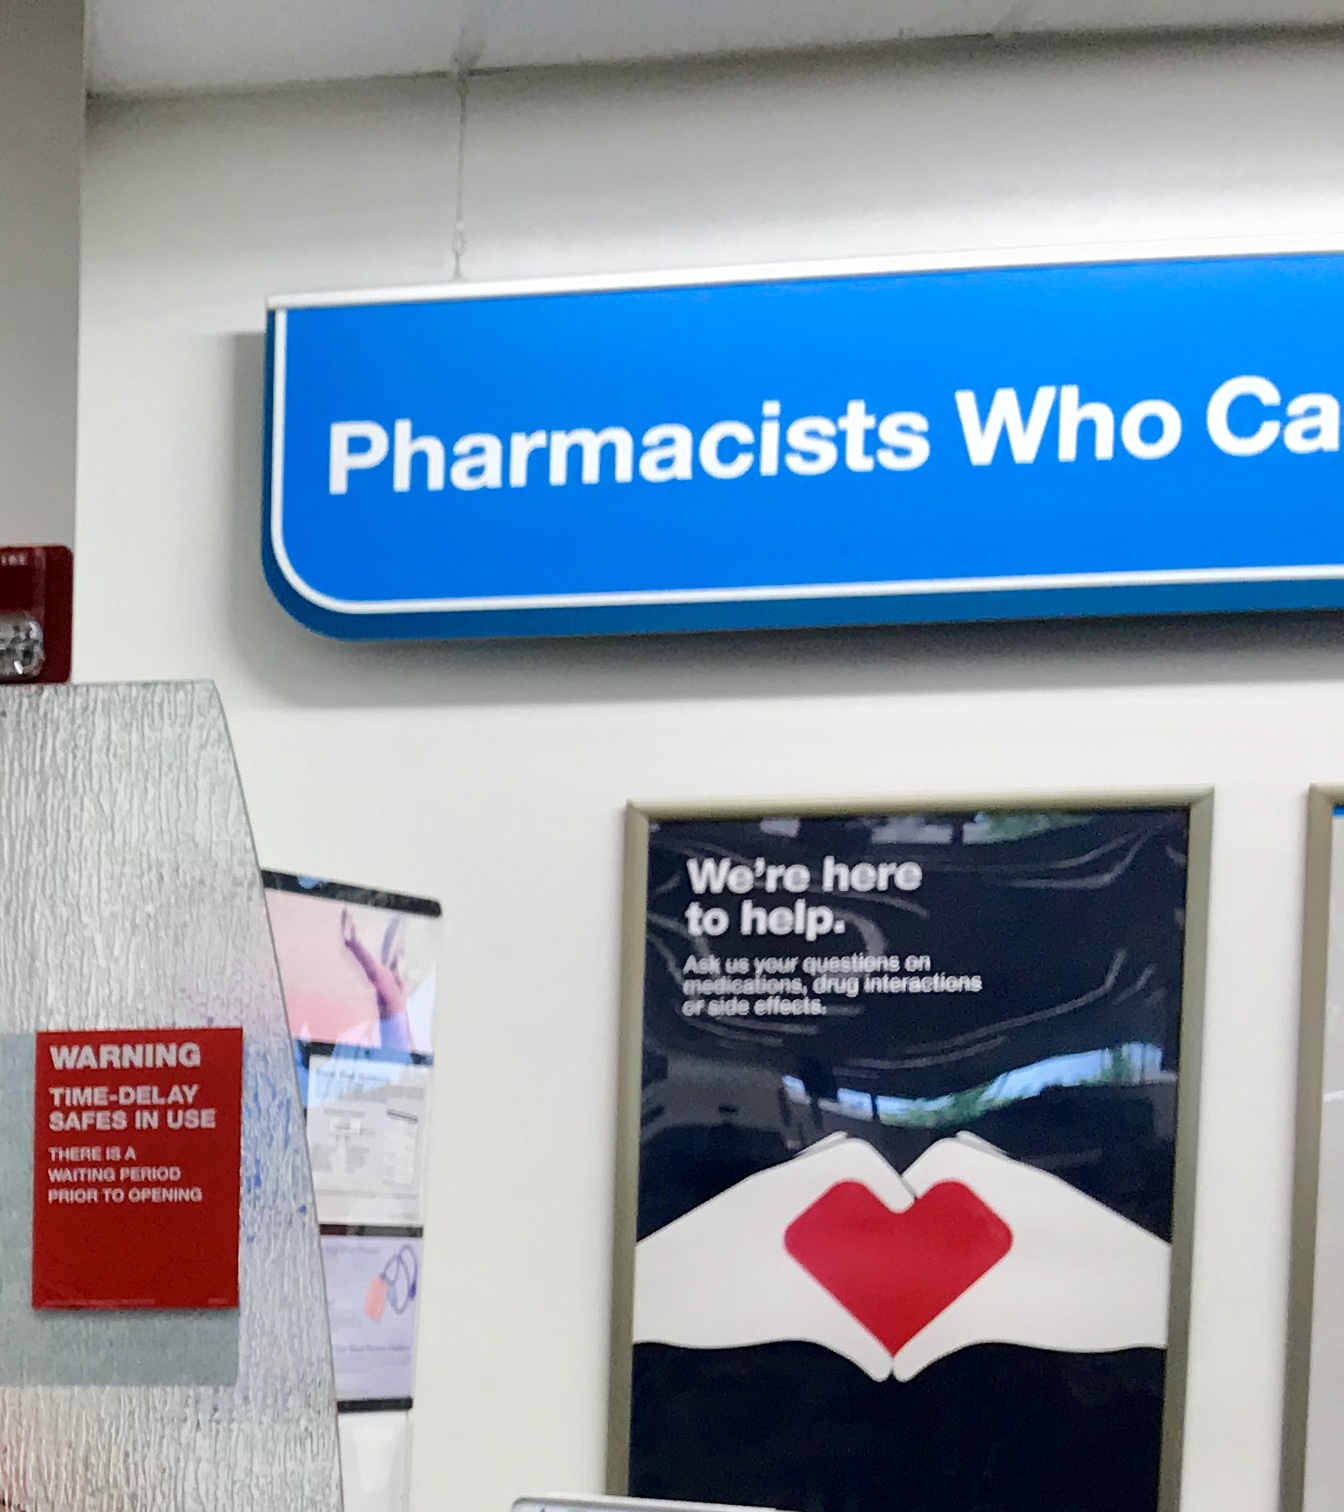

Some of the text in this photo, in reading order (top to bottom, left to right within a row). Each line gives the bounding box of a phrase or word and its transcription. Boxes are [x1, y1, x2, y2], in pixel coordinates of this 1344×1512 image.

[328, 399, 929, 495] Pharmacists
[955, 383, 1182, 467] Who
[687, 856, 923, 894] We're here
[685, 899, 845, 942] to help.
[683, 952, 931, 977] Ask us your questions on
[683, 972, 983, 998] medications, drug interactions
[682, 996, 828, 1016] or side effects.
[49, 1042, 201, 1071] WARNING
[49, 1084, 199, 1107] TIME-DELAY
[49, 1108, 216, 1132] SAFES IN USE
[48, 1146, 136, 1162] THERE IS A
[48, 1166, 181, 1183] WAITING PERIOD
[48, 1186, 203, 1204] PRIOR TO OPENING
